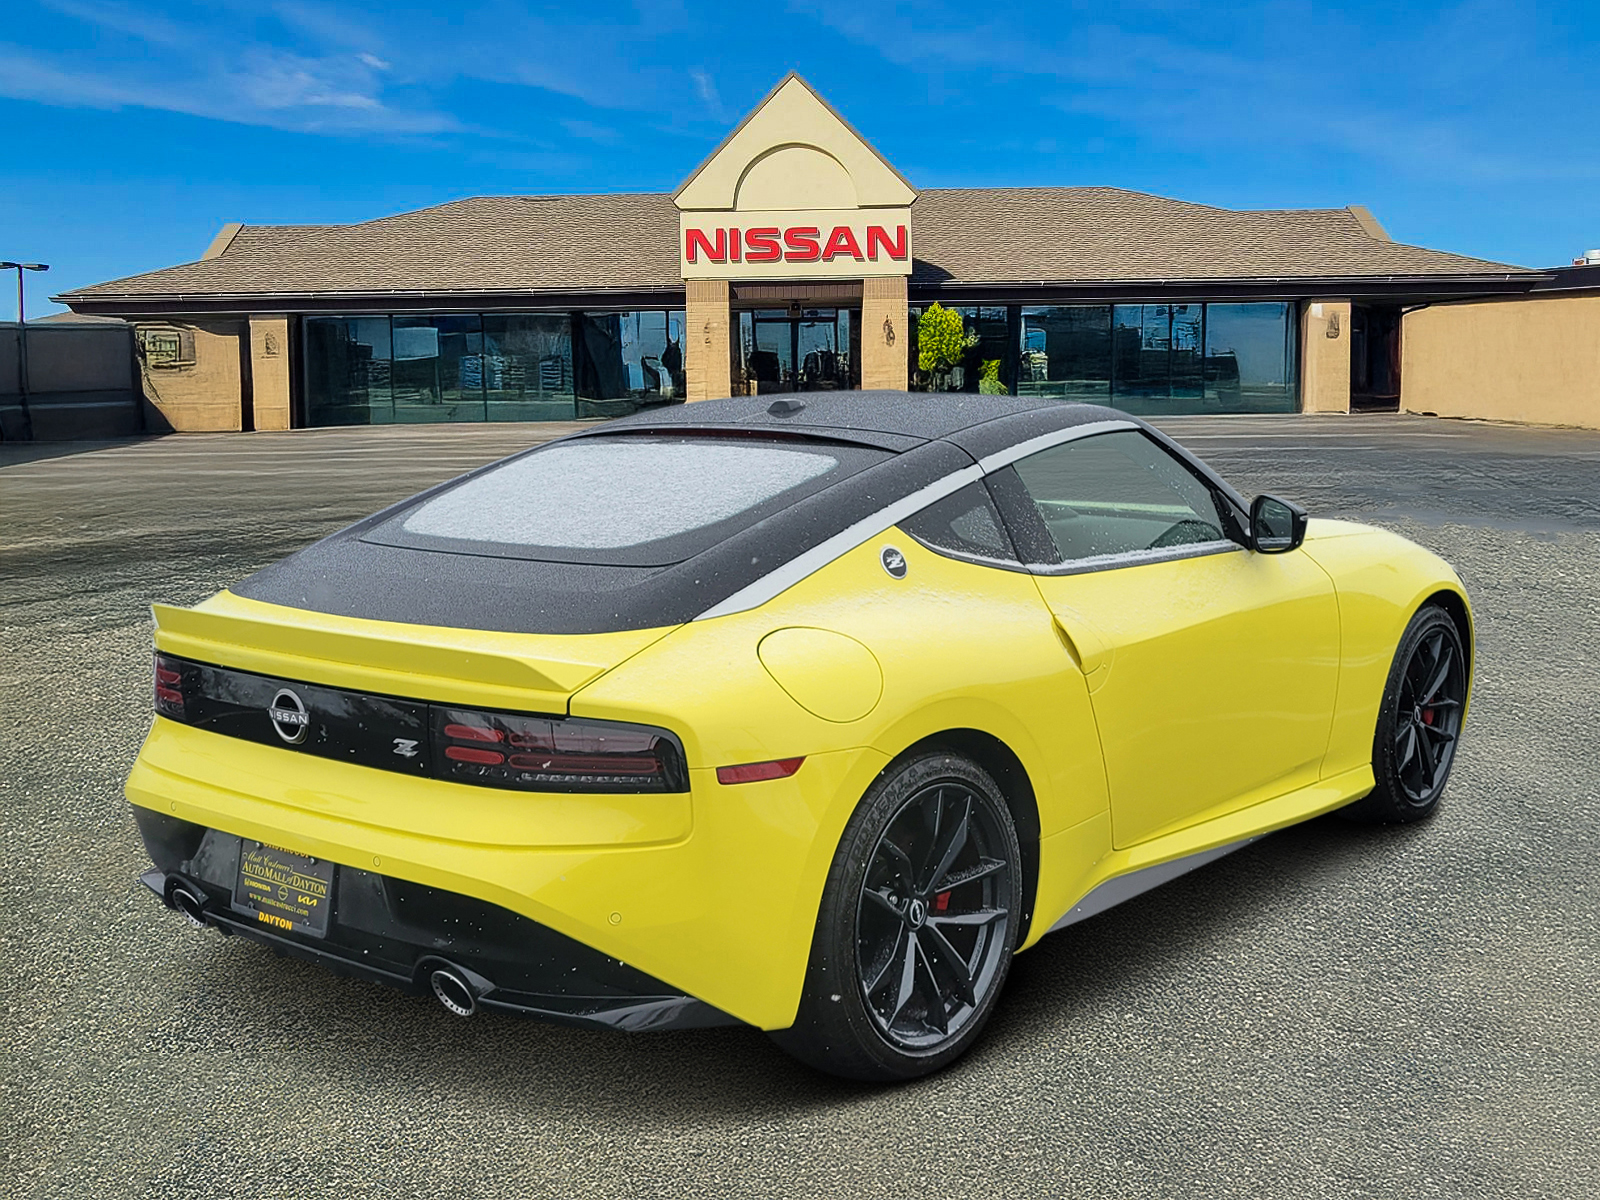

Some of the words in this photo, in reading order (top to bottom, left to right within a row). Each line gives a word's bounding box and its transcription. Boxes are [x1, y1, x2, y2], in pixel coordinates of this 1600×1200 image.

[686, 225, 908, 264] NISSAN
[268, 708, 310, 726] NISSAN
[292, 875, 327, 895] DAYTON
[258, 911, 293, 930] DAYTON
